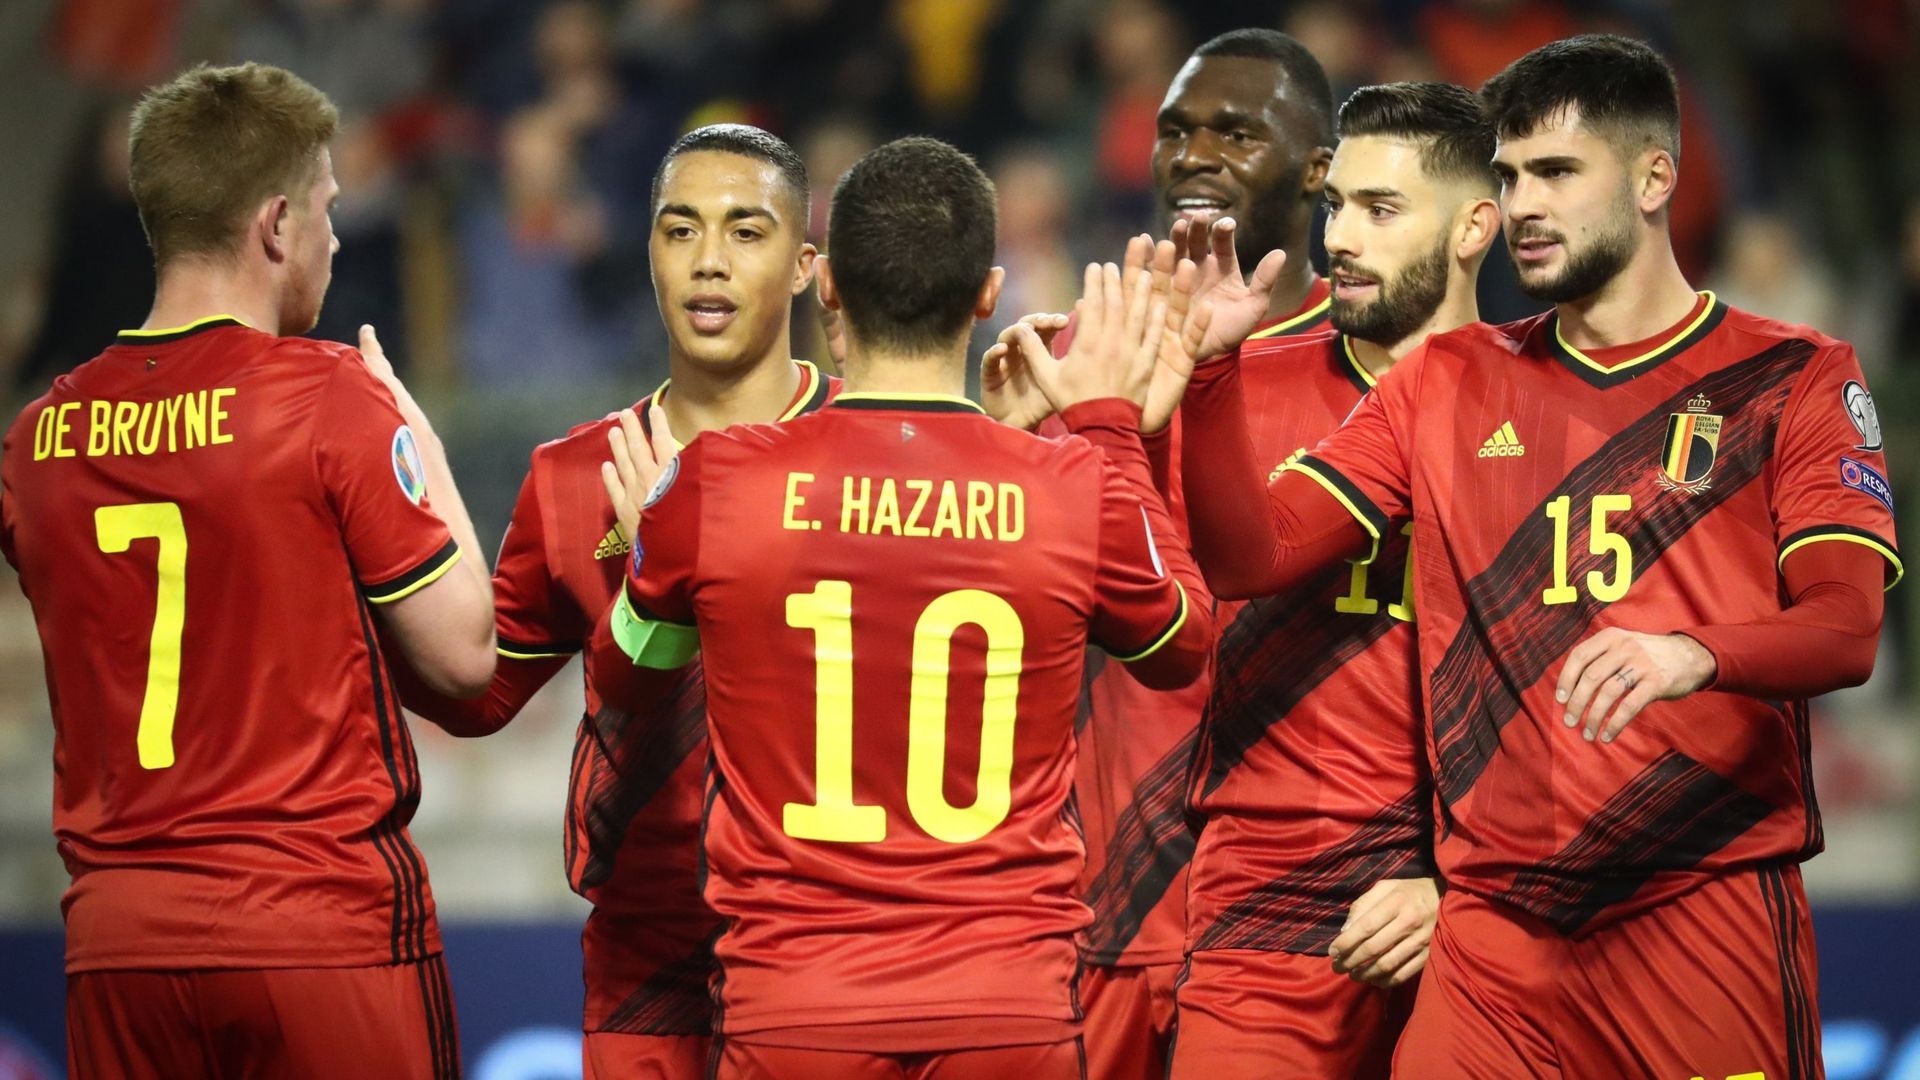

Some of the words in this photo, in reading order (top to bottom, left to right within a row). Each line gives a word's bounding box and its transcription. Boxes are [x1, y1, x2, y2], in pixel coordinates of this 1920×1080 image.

[34, 402, 81, 461] DE
[88, 388, 236, 457] BRUYNE
[1478, 445, 1525, 458] adidas
[783, 472, 822, 530] E.
[840, 476, 1025, 542] HAZARD
[1862, 472, 1893, 504] RESPEC
[594, 541, 631, 560] adida
[1543, 494, 1633, 605] 15
[95, 502, 187, 769] 7
[783, 580, 1024, 843] 10
